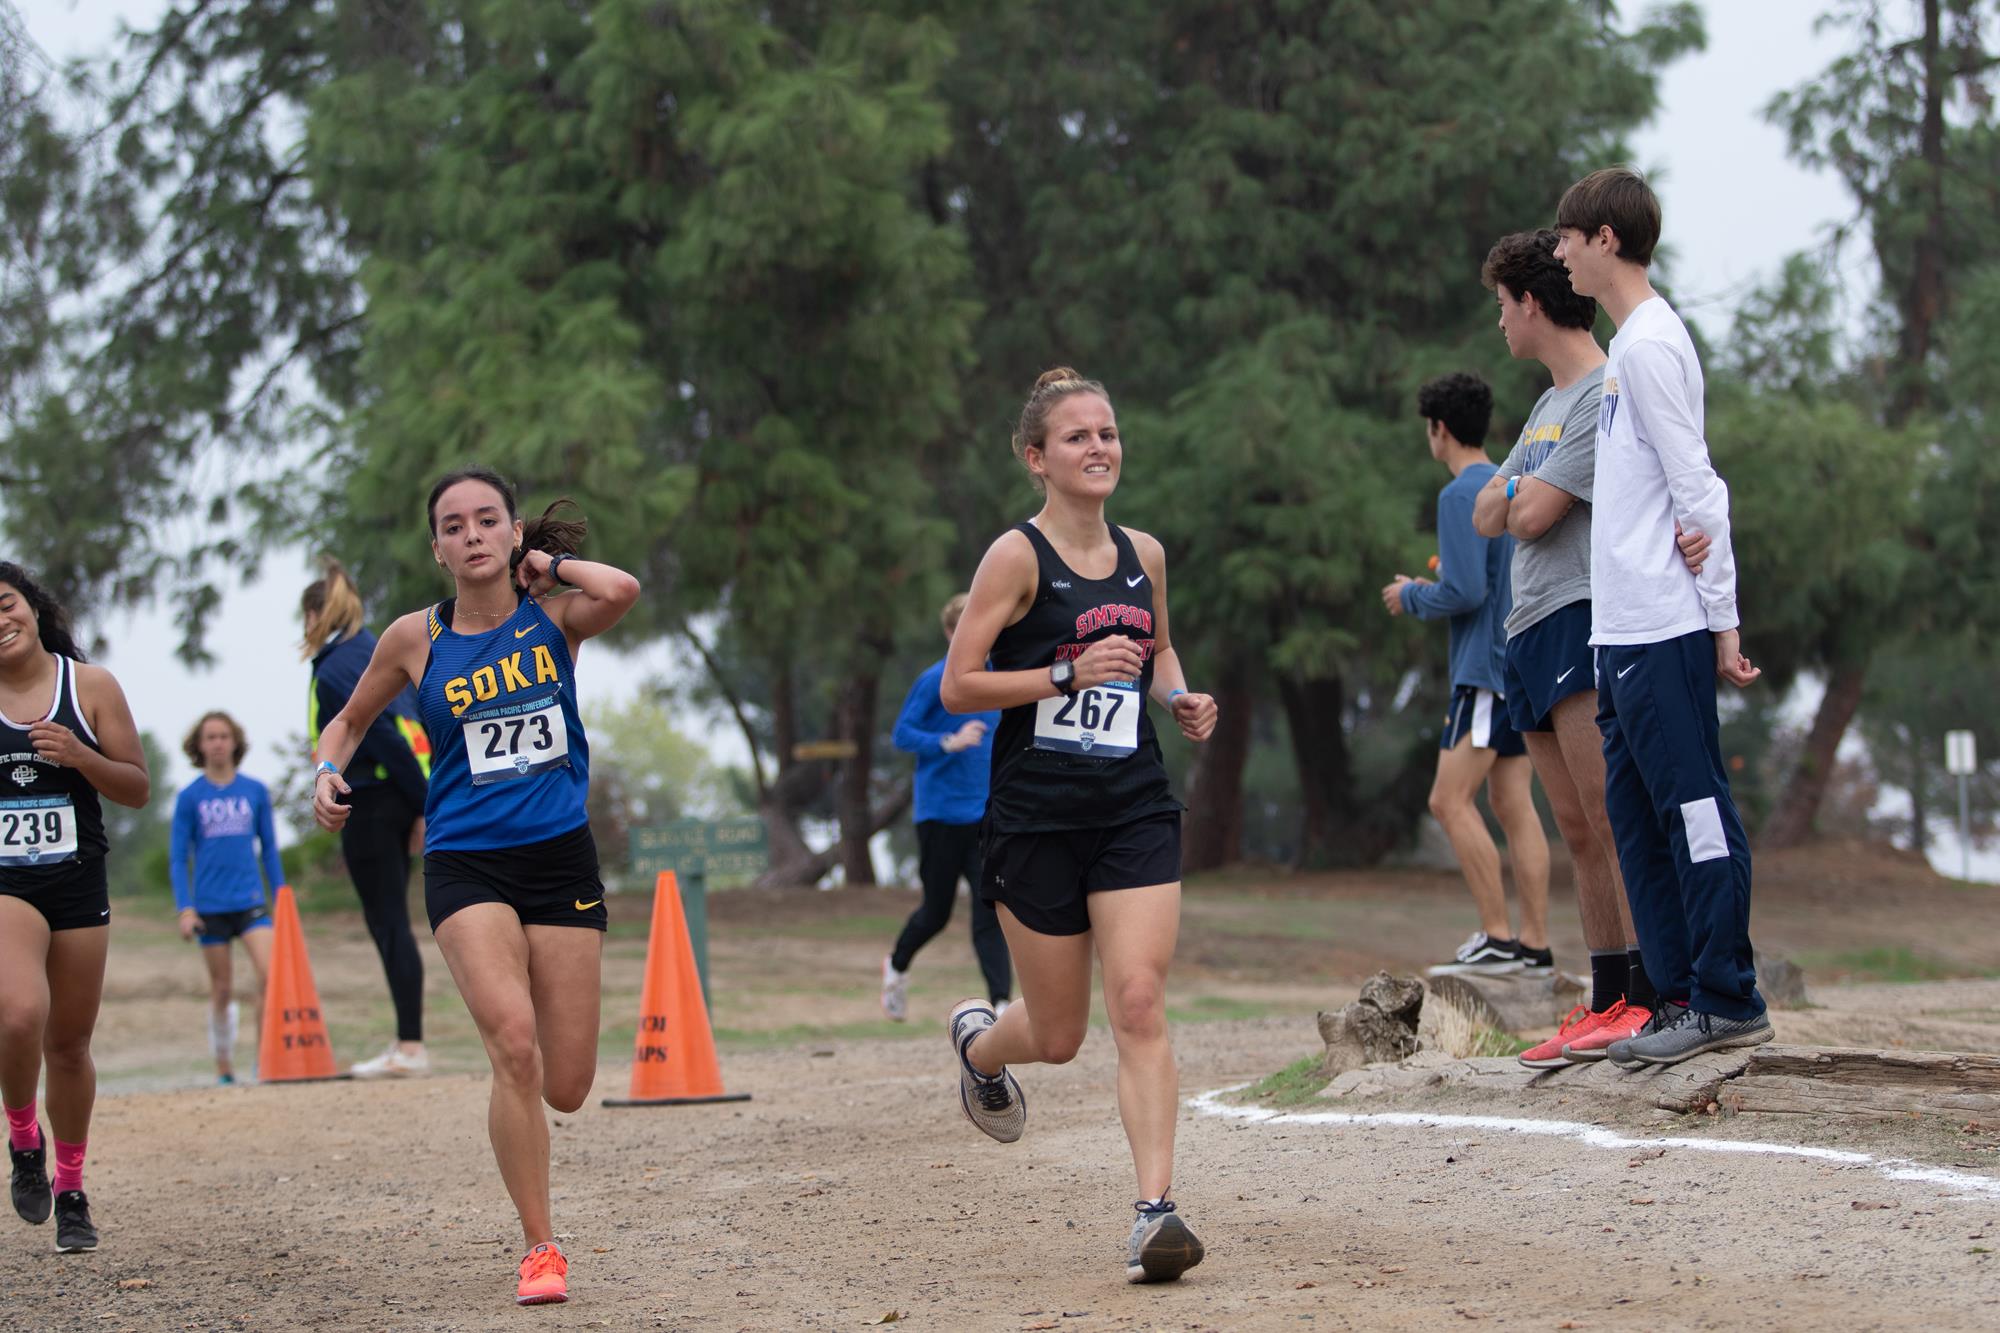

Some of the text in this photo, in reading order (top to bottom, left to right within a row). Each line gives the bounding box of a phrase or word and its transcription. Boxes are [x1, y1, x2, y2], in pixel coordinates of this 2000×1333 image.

[1076, 603, 1152, 639] SIMPSON
[444, 644, 559, 717] SOKA
[468, 695, 554, 721] CALIFORNIA PACIFIC CONFERENCE
[1052, 689, 1125, 732] 267
[480, 714, 554, 760] 273
[10, 752, 33, 762] UNION
[2, 811, 63, 846] 239
